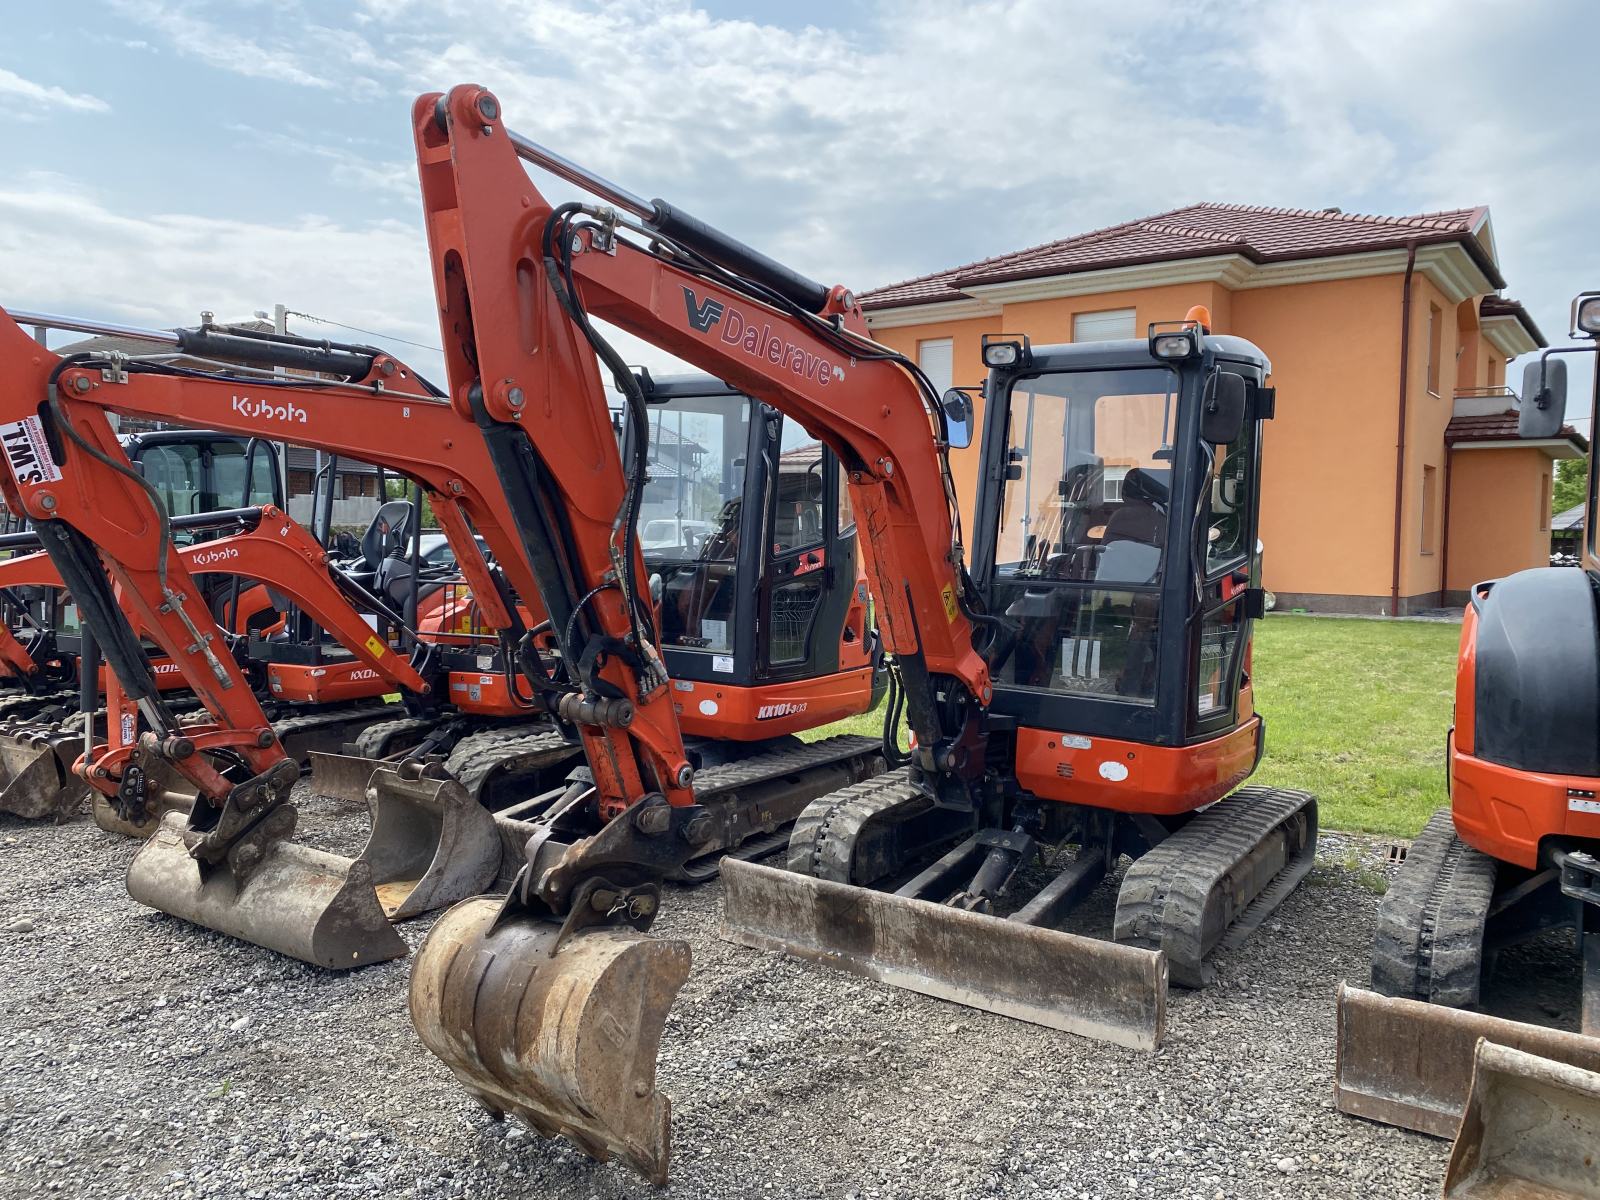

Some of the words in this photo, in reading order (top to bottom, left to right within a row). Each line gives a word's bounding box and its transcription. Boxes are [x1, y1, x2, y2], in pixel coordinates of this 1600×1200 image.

[721, 306, 832, 386] Dalerave
[232, 395, 307, 423] Kubota
[192, 547, 239, 565] Kubota
[350, 669, 380, 681] KX01
